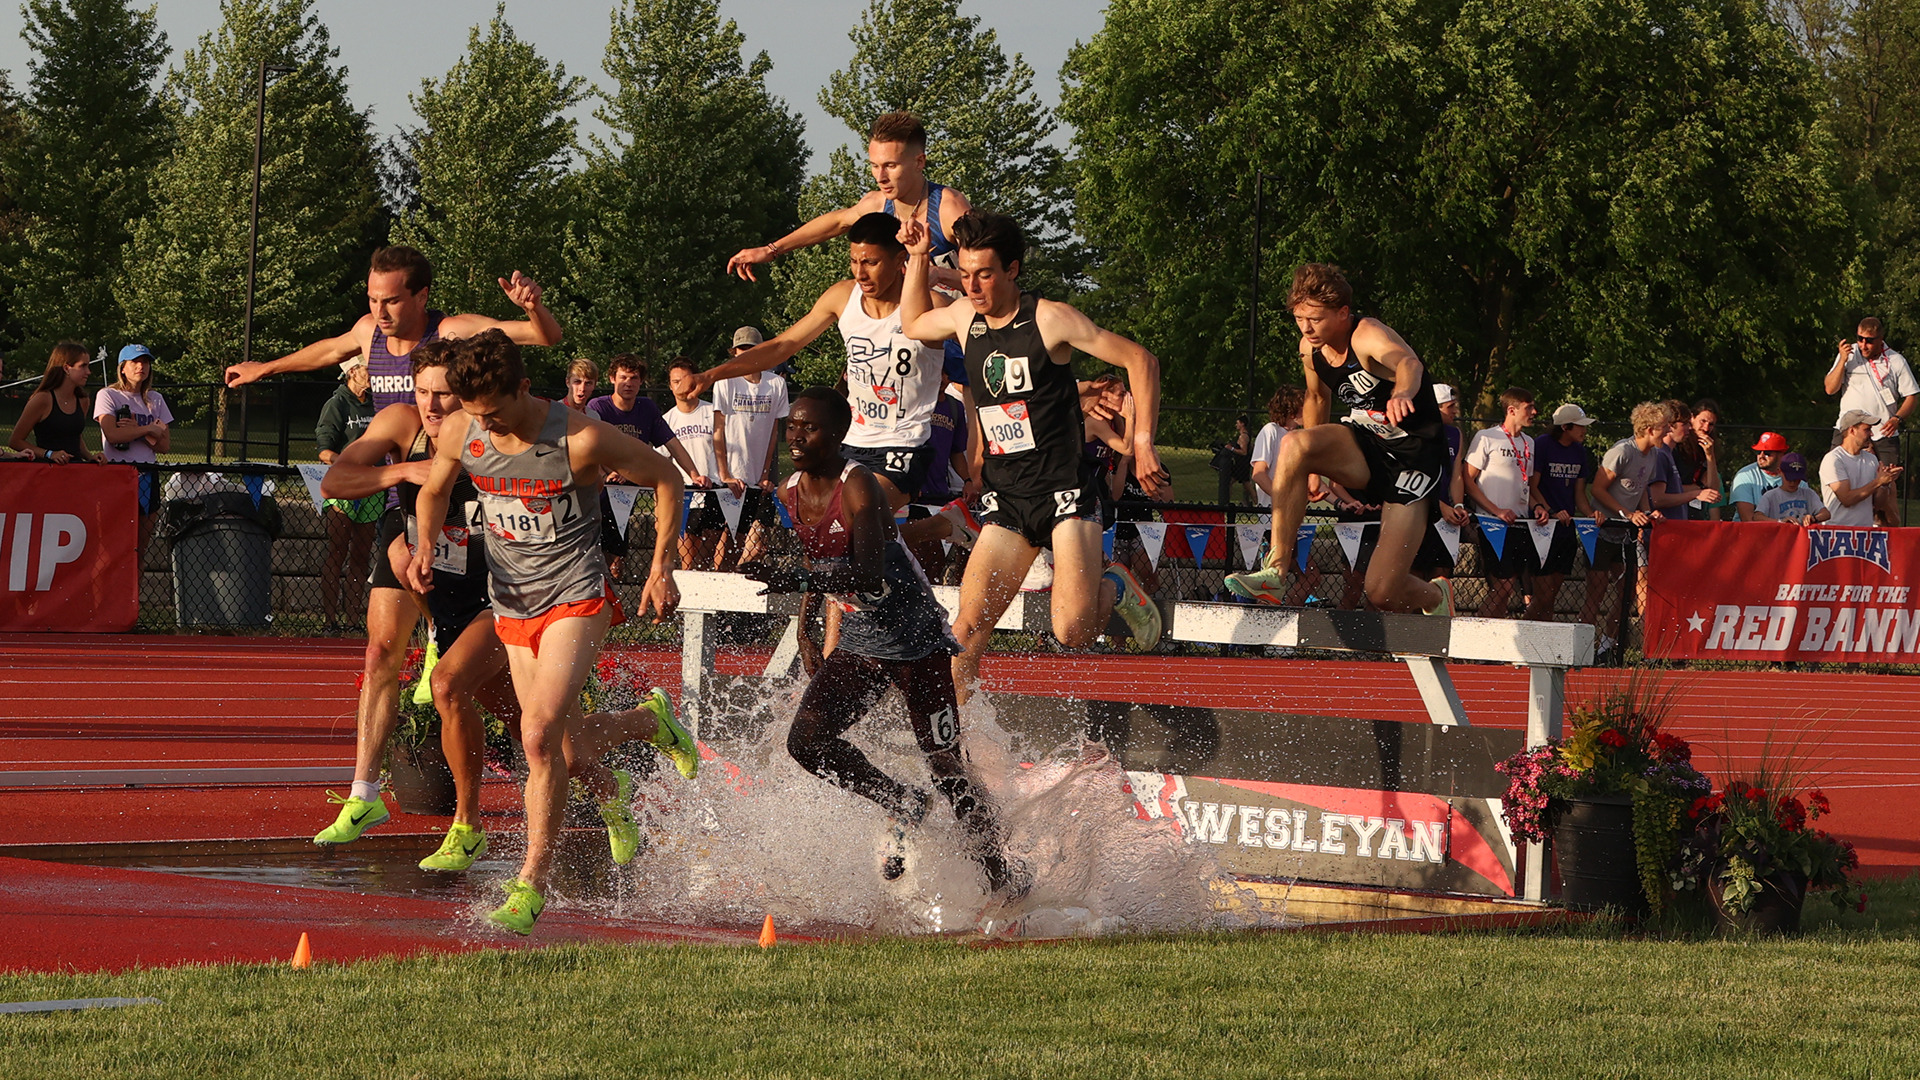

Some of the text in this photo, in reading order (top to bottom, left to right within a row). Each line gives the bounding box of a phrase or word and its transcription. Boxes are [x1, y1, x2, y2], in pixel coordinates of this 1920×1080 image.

[896, 348, 912, 376] 8
[370, 375, 415, 393] CARRO
[1010, 360, 1025, 390] 9
[1353, 372, 1374, 392] 10
[856, 397, 888, 420] 1380
[675, 424, 712, 437] ARROLL
[989, 422, 1025, 443] 1308
[469, 472, 563, 497] MILLIGAN
[1403, 470, 1424, 492] 10
[470, 502, 485, 531] 4
[558, 493, 578, 525] 2
[496, 513, 541, 532] 1181
[1807, 529, 1891, 575] NAIA
[1775, 584, 1910, 603] BATTLE FOR THE
[1705, 604, 1920, 653] RED BANN
[938, 710, 951, 742] 6
[1184, 801, 1445, 863] WESLEYAN
